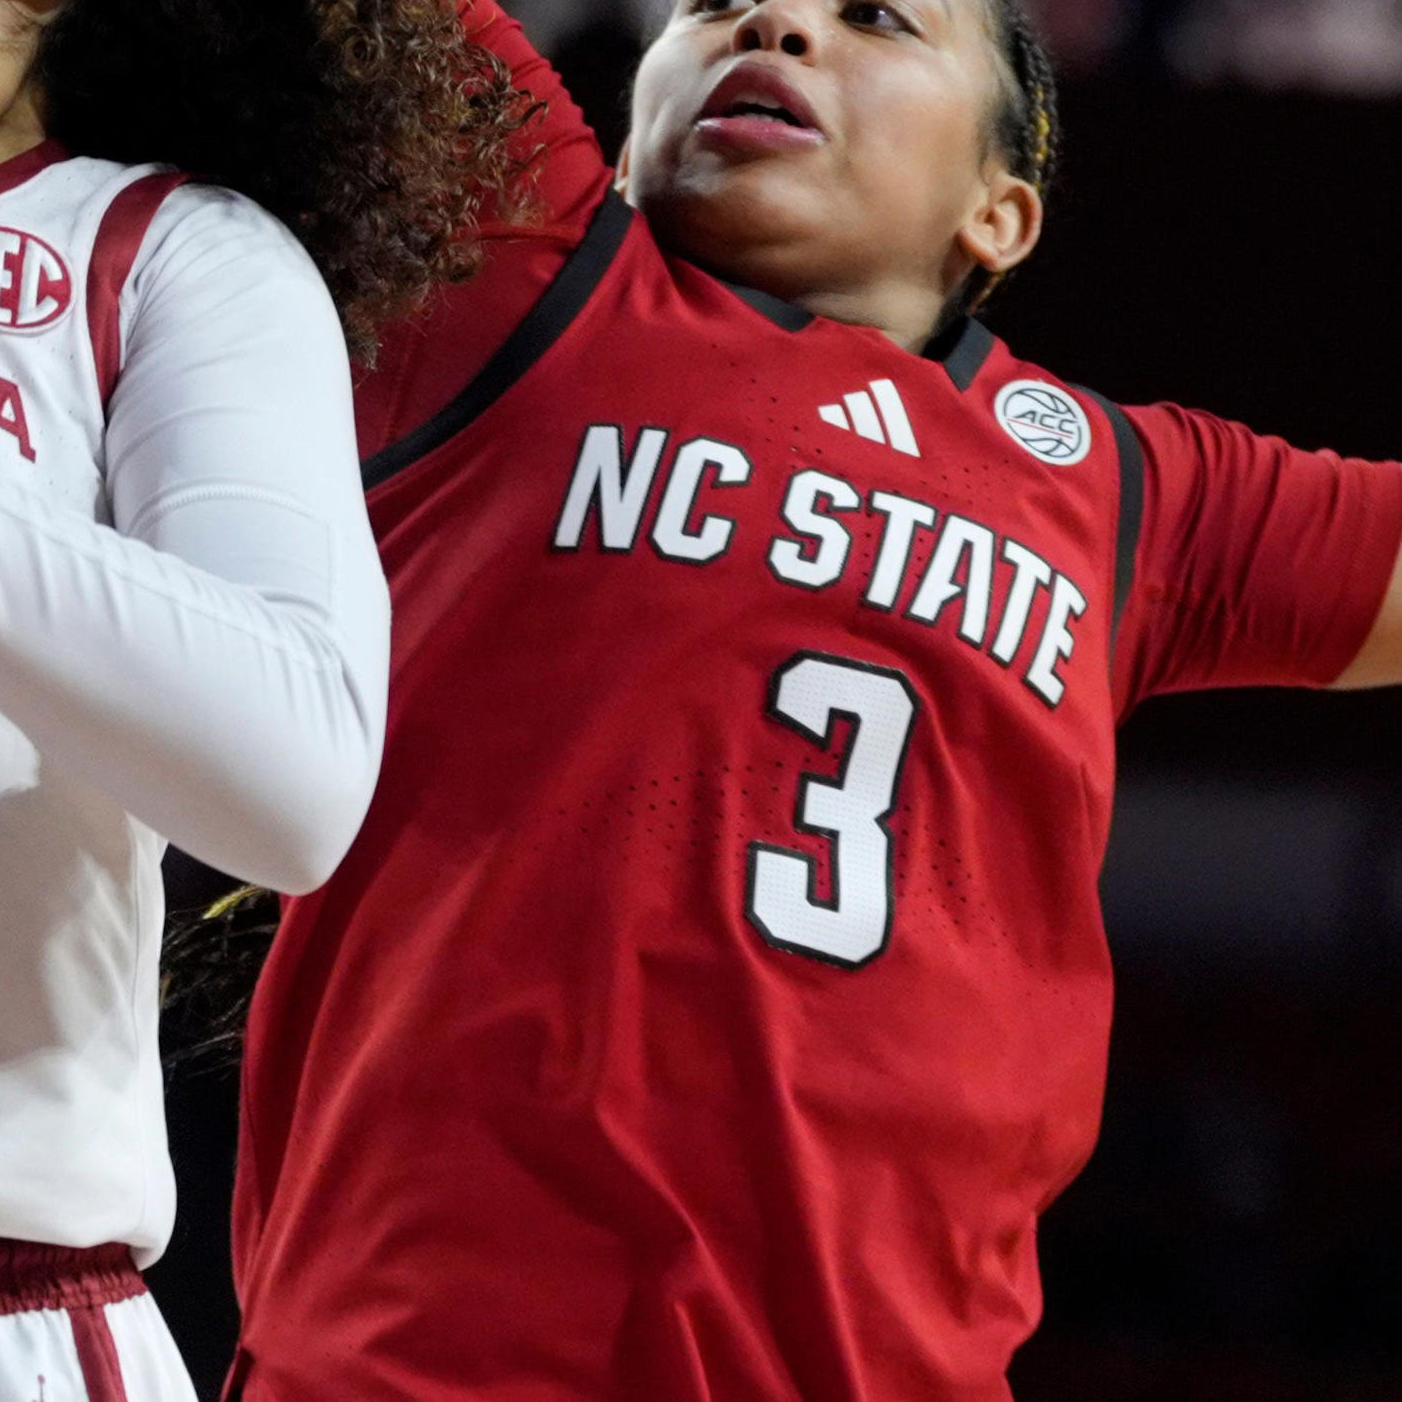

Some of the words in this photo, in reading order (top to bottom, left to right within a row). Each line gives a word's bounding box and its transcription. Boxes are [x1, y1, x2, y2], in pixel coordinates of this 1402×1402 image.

[549, 422, 753, 565] NC
[766, 467, 1089, 711] STATE
[1013, 409, 1078, 435] ACC
[743, 648, 923, 971] 3
